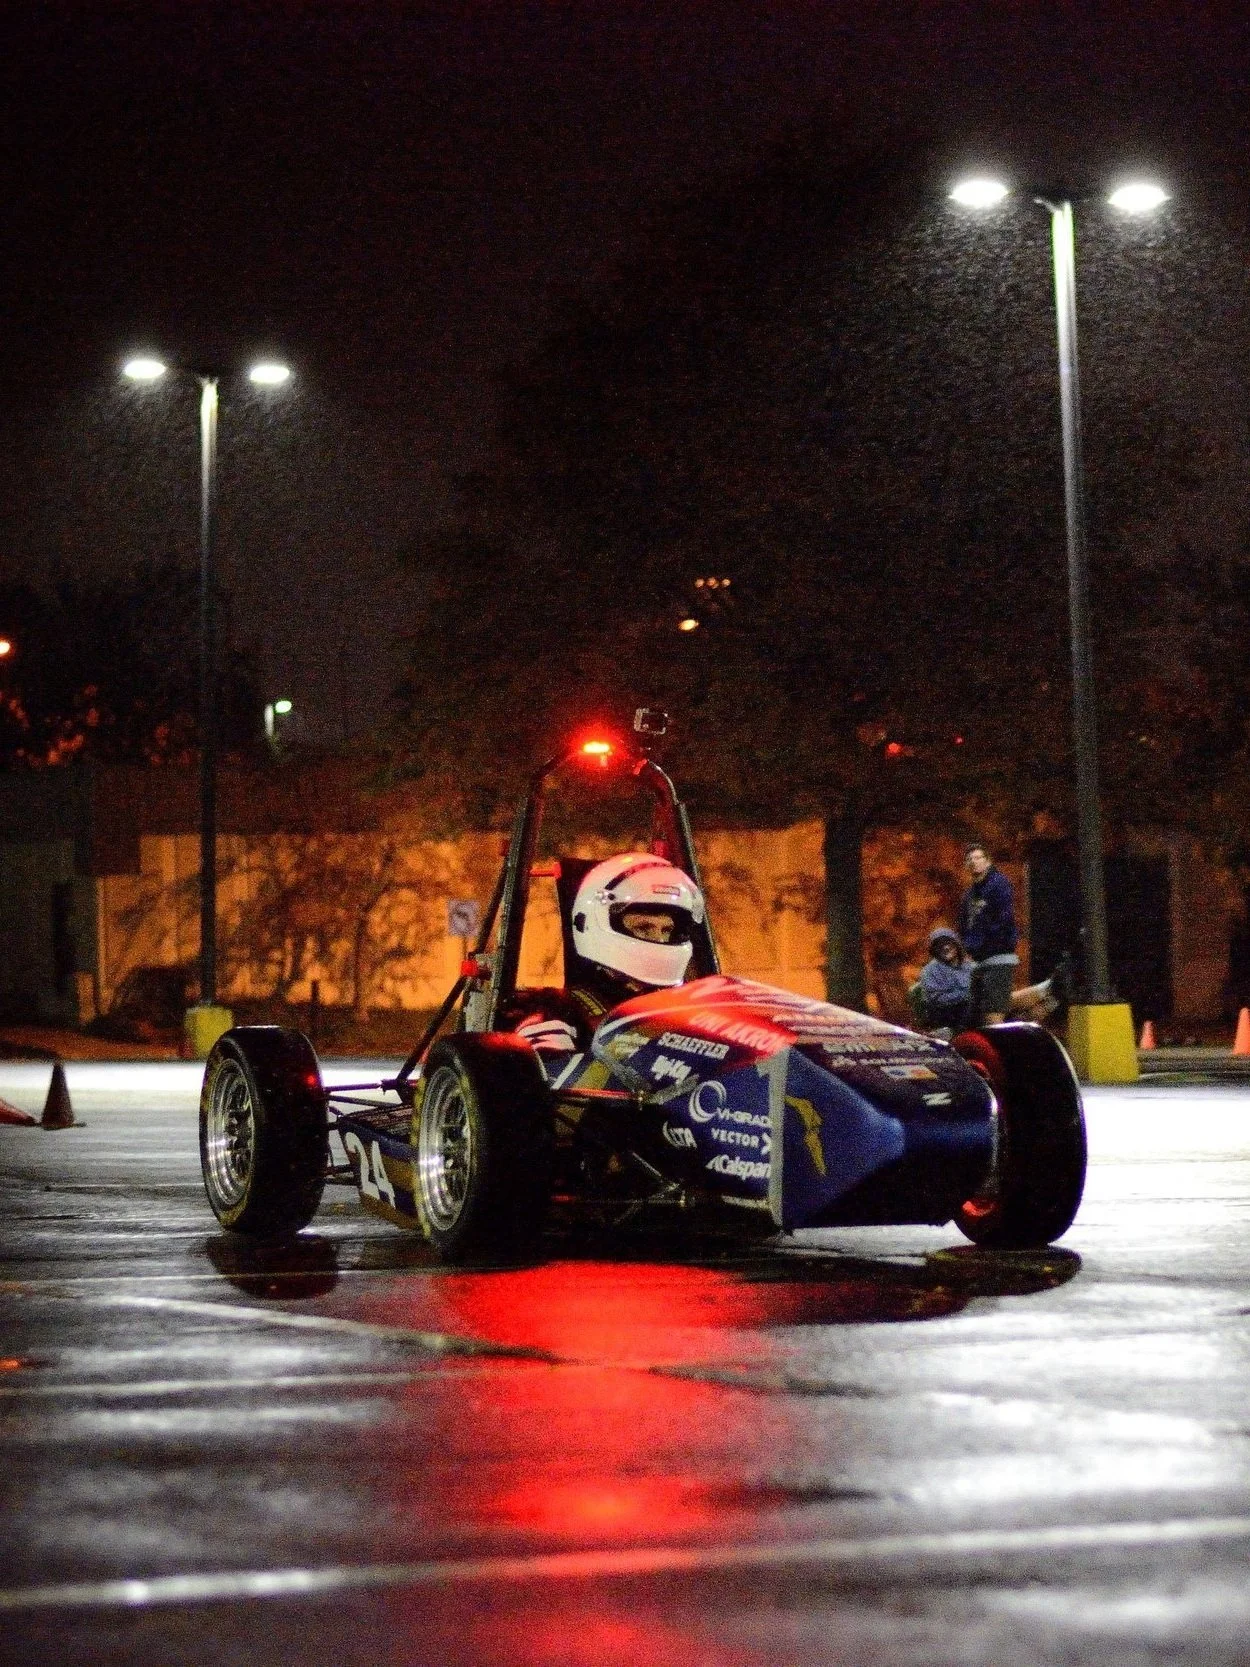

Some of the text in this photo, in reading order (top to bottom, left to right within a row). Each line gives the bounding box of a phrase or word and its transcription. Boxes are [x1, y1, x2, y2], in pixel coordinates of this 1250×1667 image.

[658, 1031, 730, 1060] SCHAEFFLER
[716, 1106, 772, 1129] VI-GRAD
[711, 1127, 760, 1149] VECTOR
[345, 1131, 396, 1209] 24
[714, 1154, 772, 1181] Calspan
